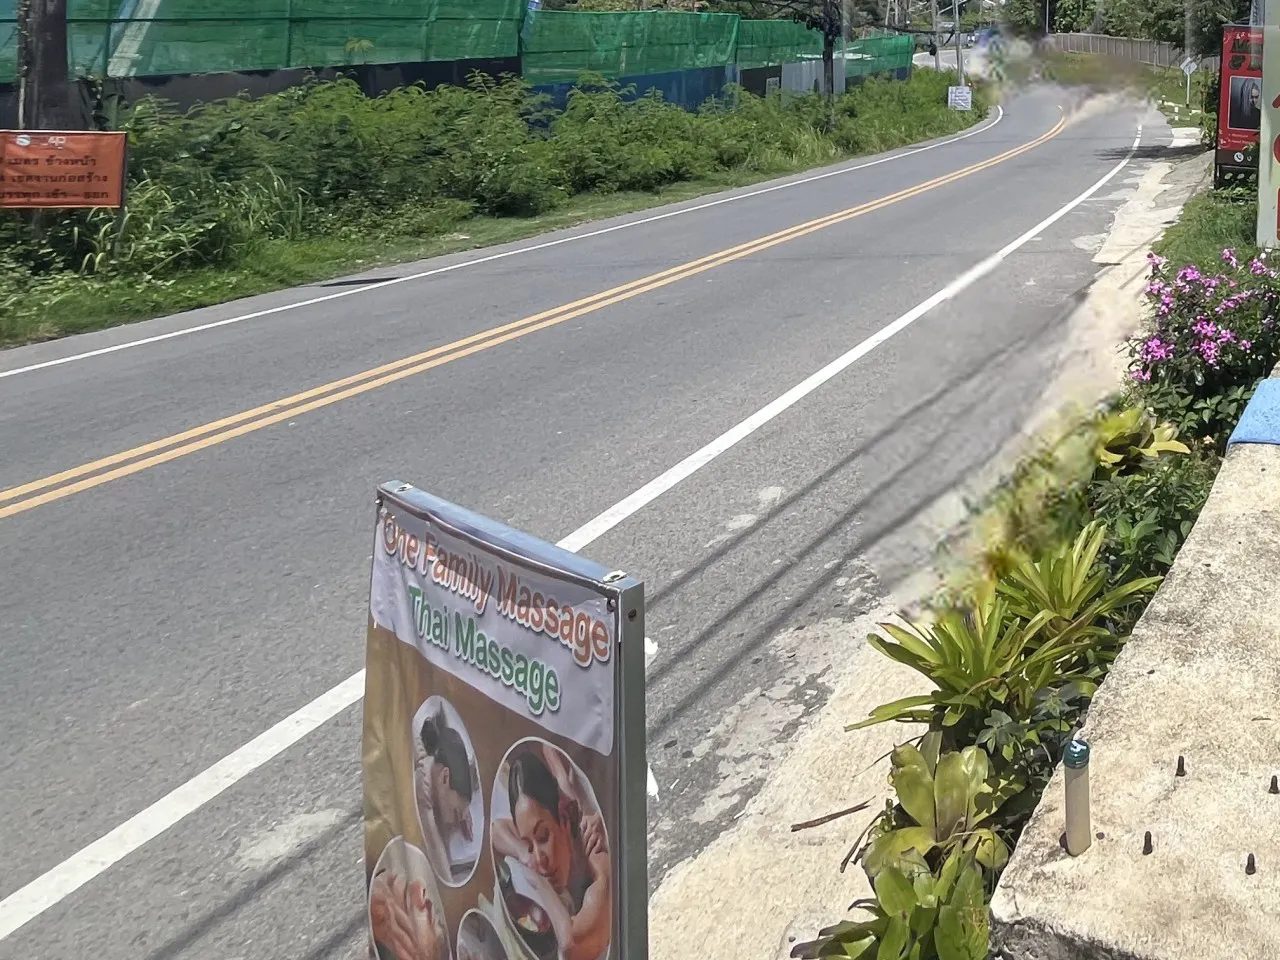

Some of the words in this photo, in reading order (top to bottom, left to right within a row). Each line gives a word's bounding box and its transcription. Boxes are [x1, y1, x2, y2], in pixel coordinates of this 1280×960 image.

[382, 514, 420, 569] One
[422, 533, 492, 613] Family
[496, 565, 611, 667] Massage
[408, 586, 452, 648] Thai
[454, 614, 561, 716] Massage
